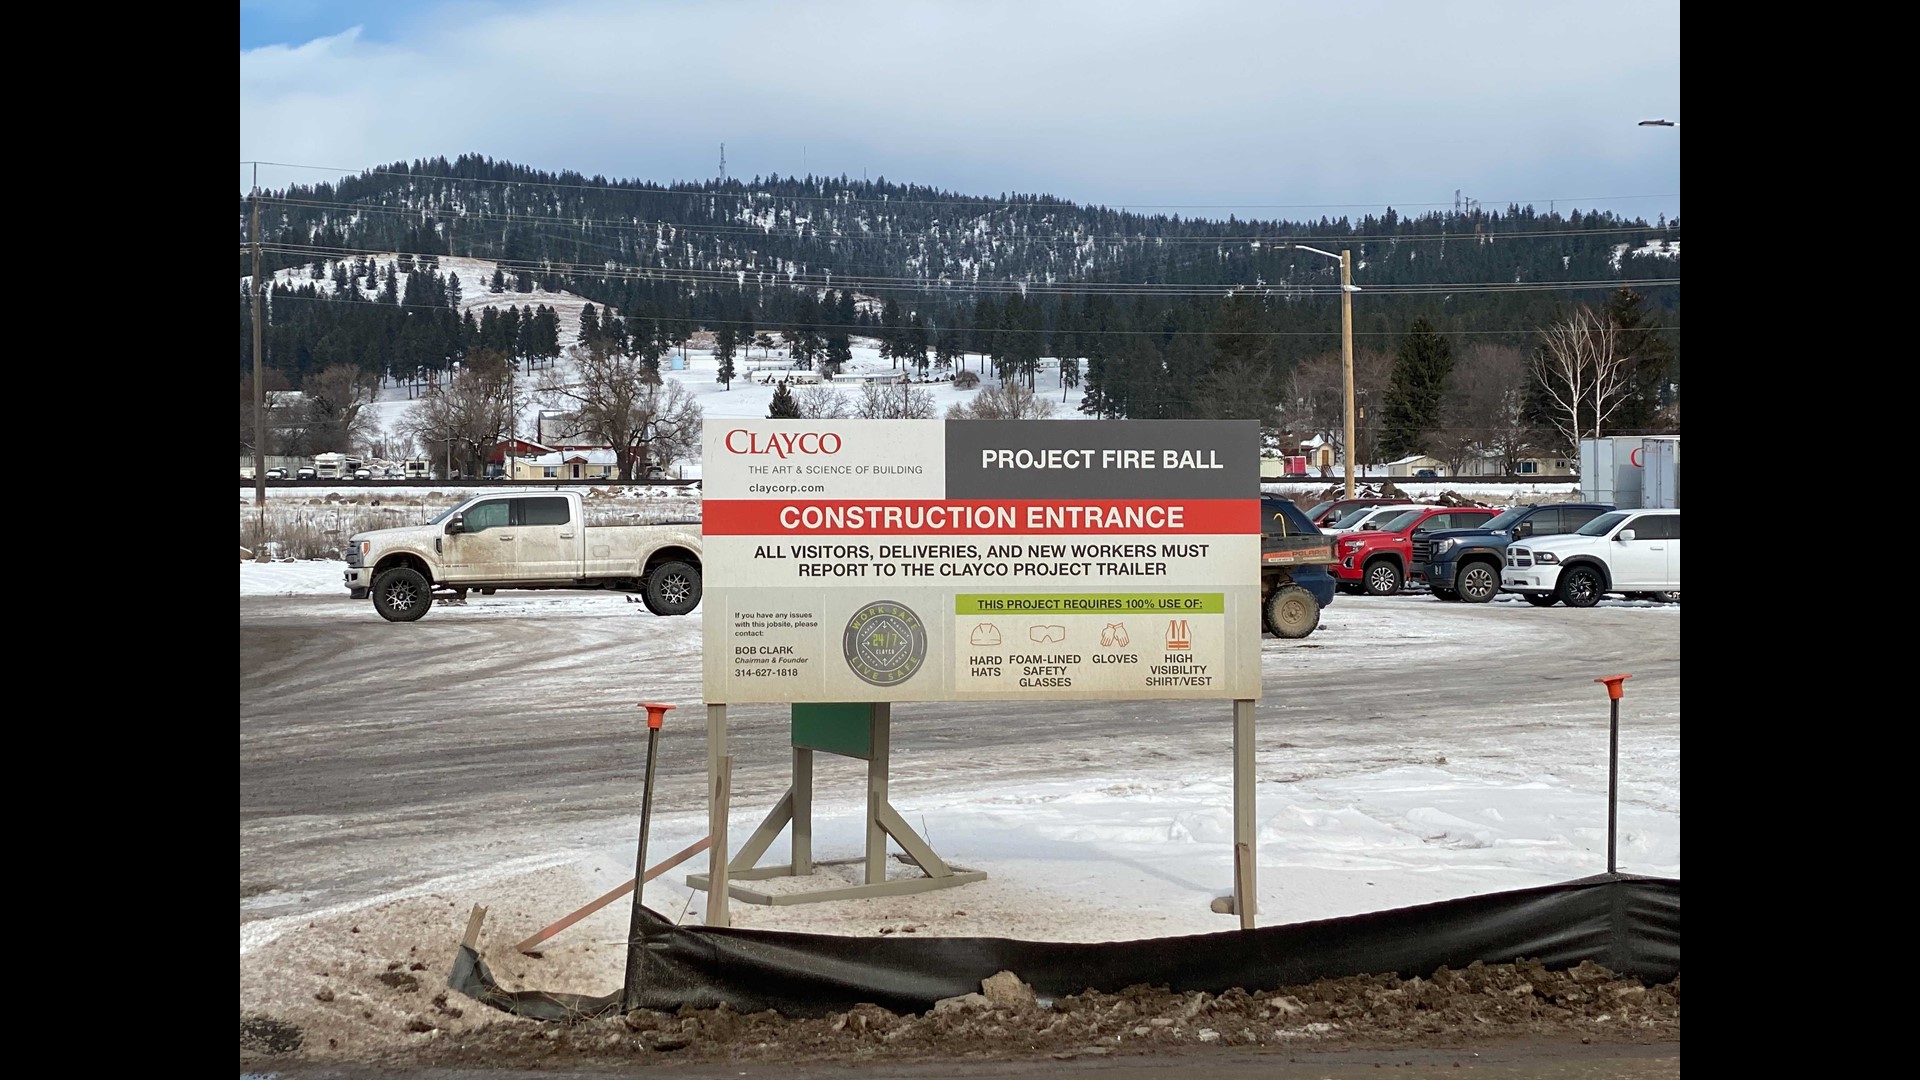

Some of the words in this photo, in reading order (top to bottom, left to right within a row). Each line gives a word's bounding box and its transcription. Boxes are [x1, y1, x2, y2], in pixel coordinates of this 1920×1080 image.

[725, 429, 842, 459] CLAYCO
[982, 449, 1096, 469] PROJECT
[1102, 449, 1156, 469] FIRE
[1163, 449, 1224, 469] BALL
[748, 465, 769, 475] THE
[772, 465, 793, 475] ART
[796, 465, 803, 475] &
[806, 465, 852, 475] SCIENCE
[855, 465, 870, 475] OF
[873, 465, 923, 475] BUILDING
[749, 484, 825, 494] claycorp.com
[779, 505, 1016, 529] CONSTRUCTION
[1027, 505, 1185, 529] ENTRANCE
[754, 545, 787, 559] ALL
[791, 544, 874, 561] VISITORS,
[879, 544, 982, 561] DELIVERIES,
[986, 544, 1023, 559] AND
[1028, 544, 1067, 558] NEW
[1070, 544, 1157, 558] WORKERS
[1161, 544, 1210, 558] MUST
[798, 563, 869, 577] REPORT
[873, 563, 897, 577] TO
[901, 563, 935, 577] THE
[939, 563, 1009, 577] CLAYCO
[1013, 563, 1092, 577] PROJECT
[1095, 562, 1167, 576] TRAILER
[977, 599, 1004, 609] THIS
[1006, 599, 1061, 609] PROJECT
[1063, 599, 1123, 609] REQUIRES
[1125, 599, 1155, 609] 100%
[1158, 599, 1181, 609] USE
[1184, 599, 1203, 609] OF:
[852, 607, 884, 630] WORK
[891, 607, 918, 630] SAFE
[734, 620, 751, 628] with
[752, 620, 765, 628] this
[766, 620, 793, 629] jobsite,
[794, 620, 819, 629] please
[872, 631, 898, 649] 24/7
[735, 646, 757, 655] BOB
[759, 646, 794, 655] CLARK
[734, 656, 770, 664] Chairman
[778, 656, 809, 664] Founder
[969, 655, 1003, 666] HARD
[1009, 654, 1082, 665] FOAM-LINED
[1091, 653, 1139, 664] GLOVES
[1164, 653, 1193, 664] HIGH
[734, 668, 799, 678] 314-627-1818
[851, 656, 880, 681] LIVE
[887, 656, 918, 681] SAFE
[971, 666, 1002, 677] HATS
[1023, 665, 1068, 676] SAFETY
[1149, 665, 1208, 675] VISIBILITY
[1018, 677, 1072, 688] GLASSES
[1145, 676, 1213, 687] SHIRT/VEST
